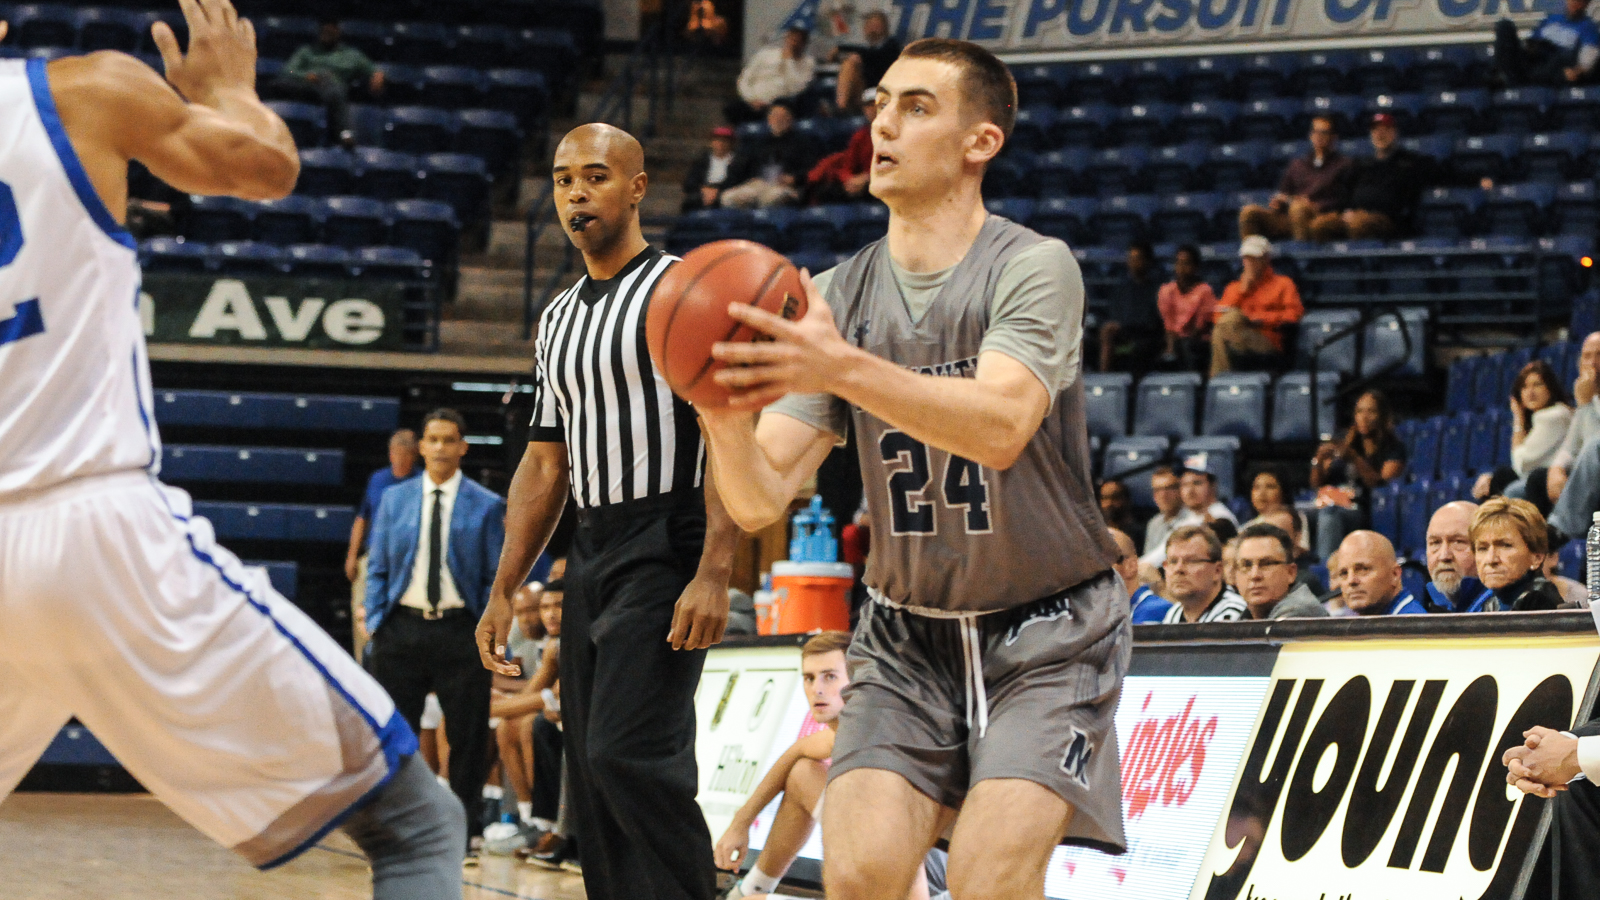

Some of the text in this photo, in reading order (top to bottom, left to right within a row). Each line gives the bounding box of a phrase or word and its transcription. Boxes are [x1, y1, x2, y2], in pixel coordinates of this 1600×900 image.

[888, 0, 1010, 41] THE
[188, 278, 386, 345] Ave
[878, 428, 994, 537] 24
